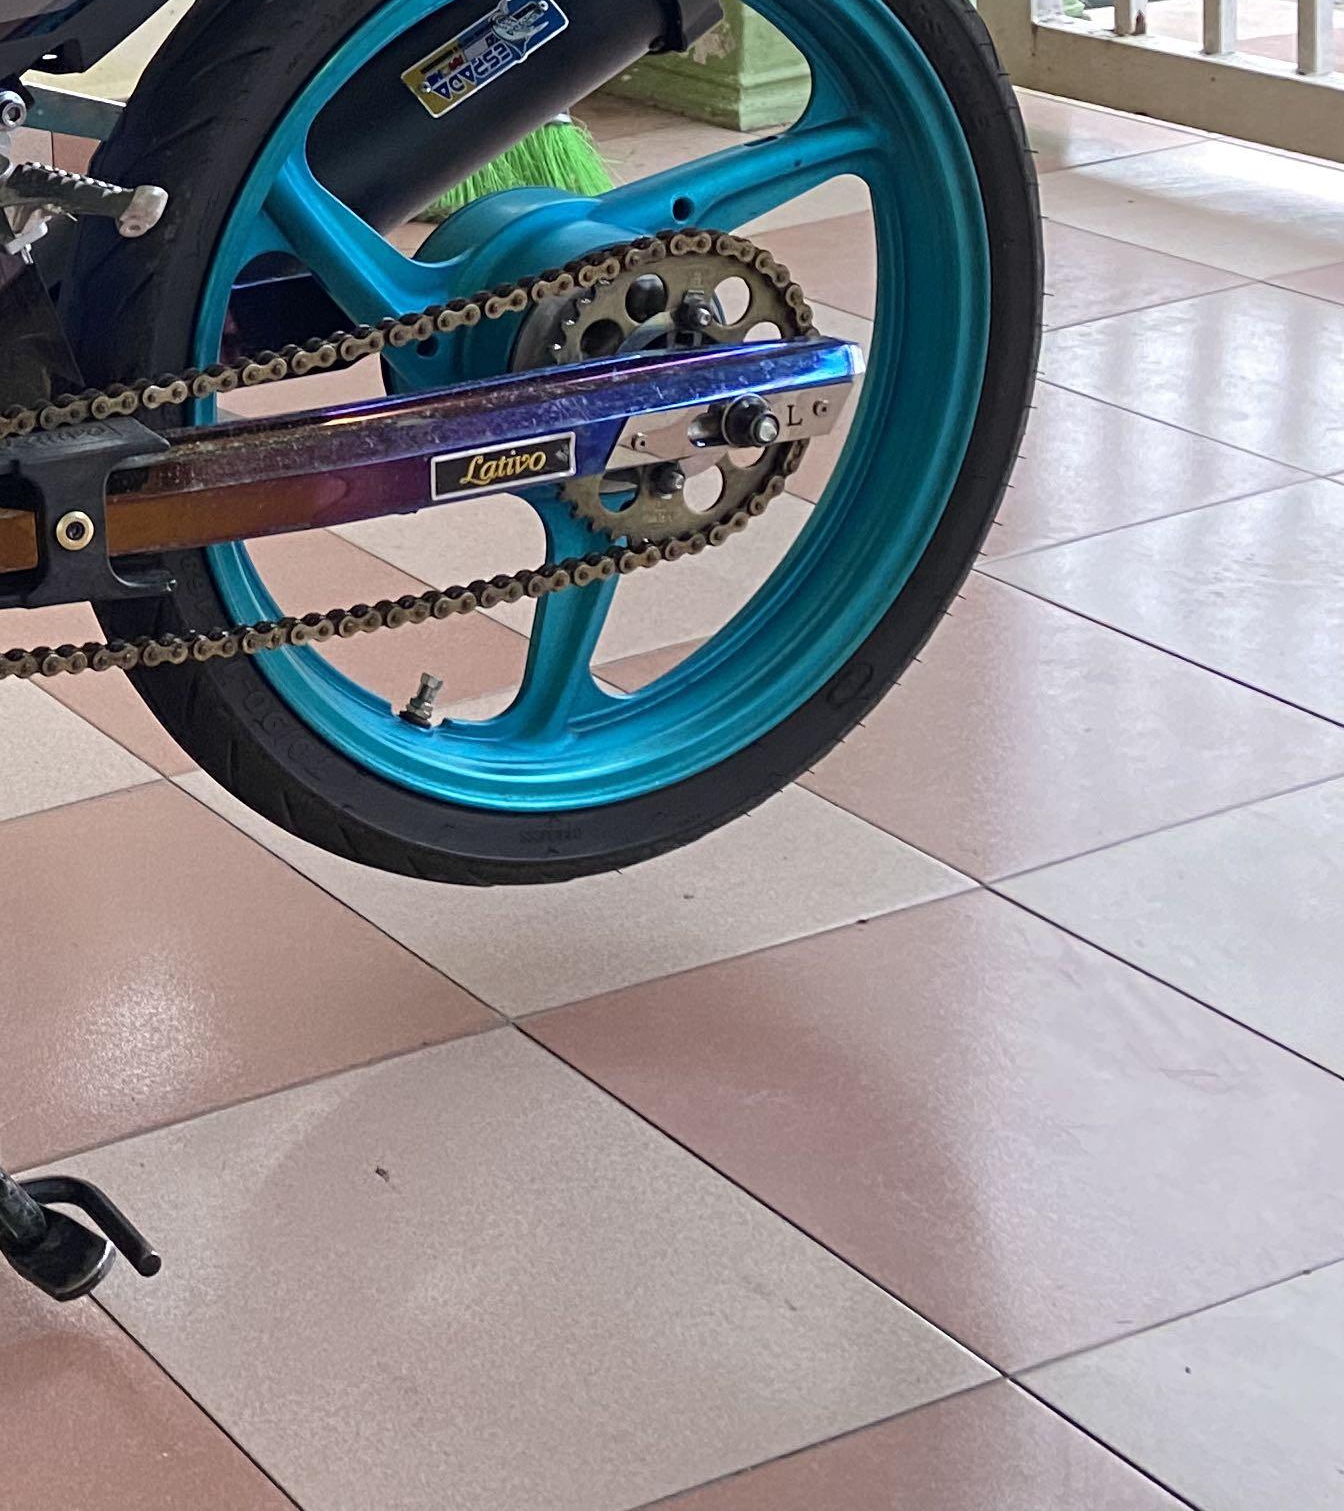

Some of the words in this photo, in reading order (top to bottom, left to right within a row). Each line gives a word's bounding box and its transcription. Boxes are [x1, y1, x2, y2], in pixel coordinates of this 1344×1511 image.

[431, 41, 513, 100] ESPADA
[787, 403, 804, 427] L
[459, 449, 547, 486] Lativo
